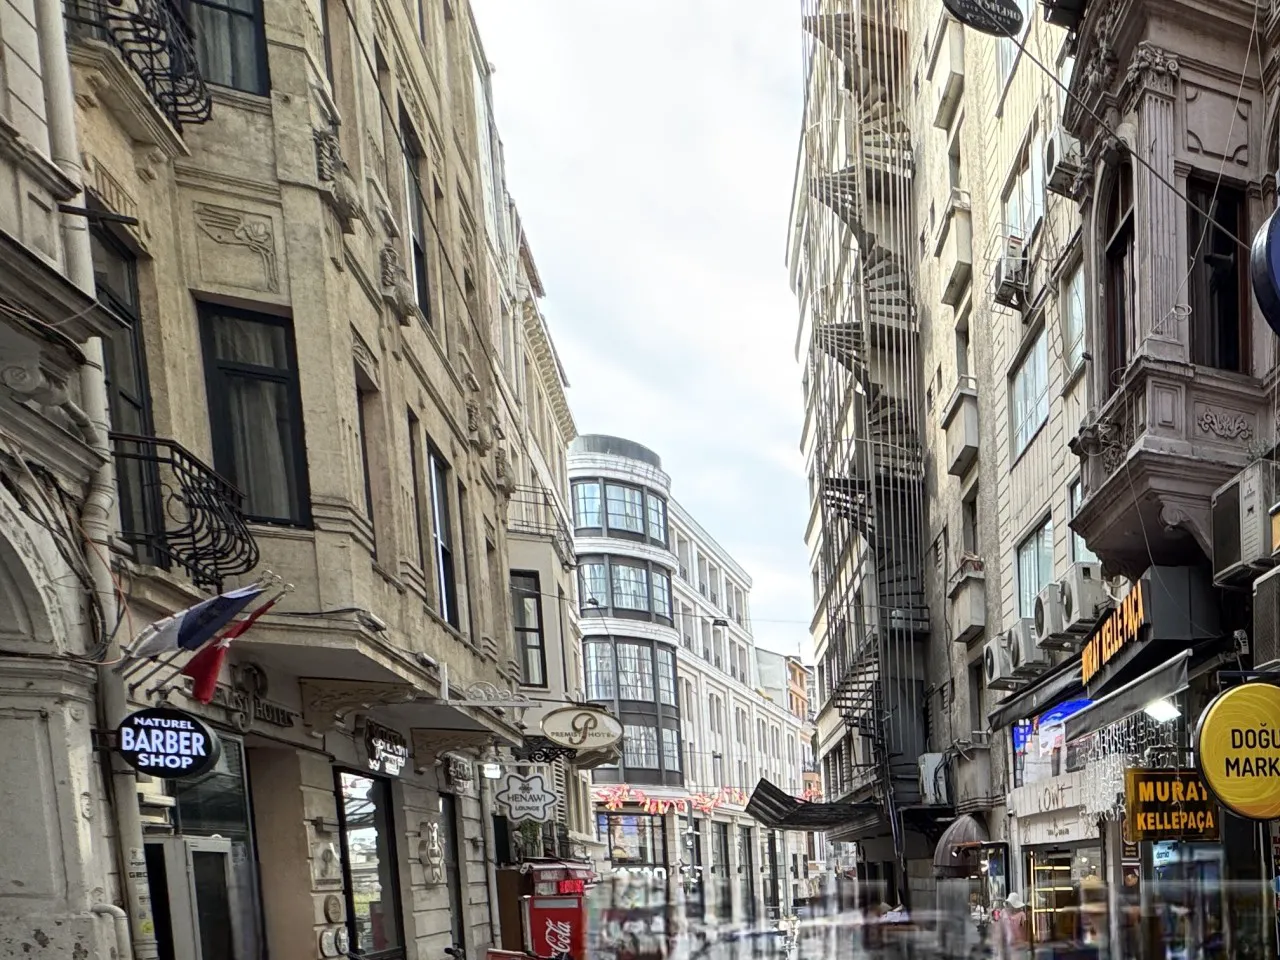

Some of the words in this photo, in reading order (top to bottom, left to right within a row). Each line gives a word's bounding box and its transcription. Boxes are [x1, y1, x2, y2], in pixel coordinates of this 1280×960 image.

[133, 716, 196, 730] NATUREL
[121, 727, 207, 757] BARBER
[137, 753, 194, 769] SHOP
[507, 794, 546, 802] HENAWI
[1137, 780, 1209, 802] MURAT
[1136, 811, 1215, 833] KELLEPAÇA
